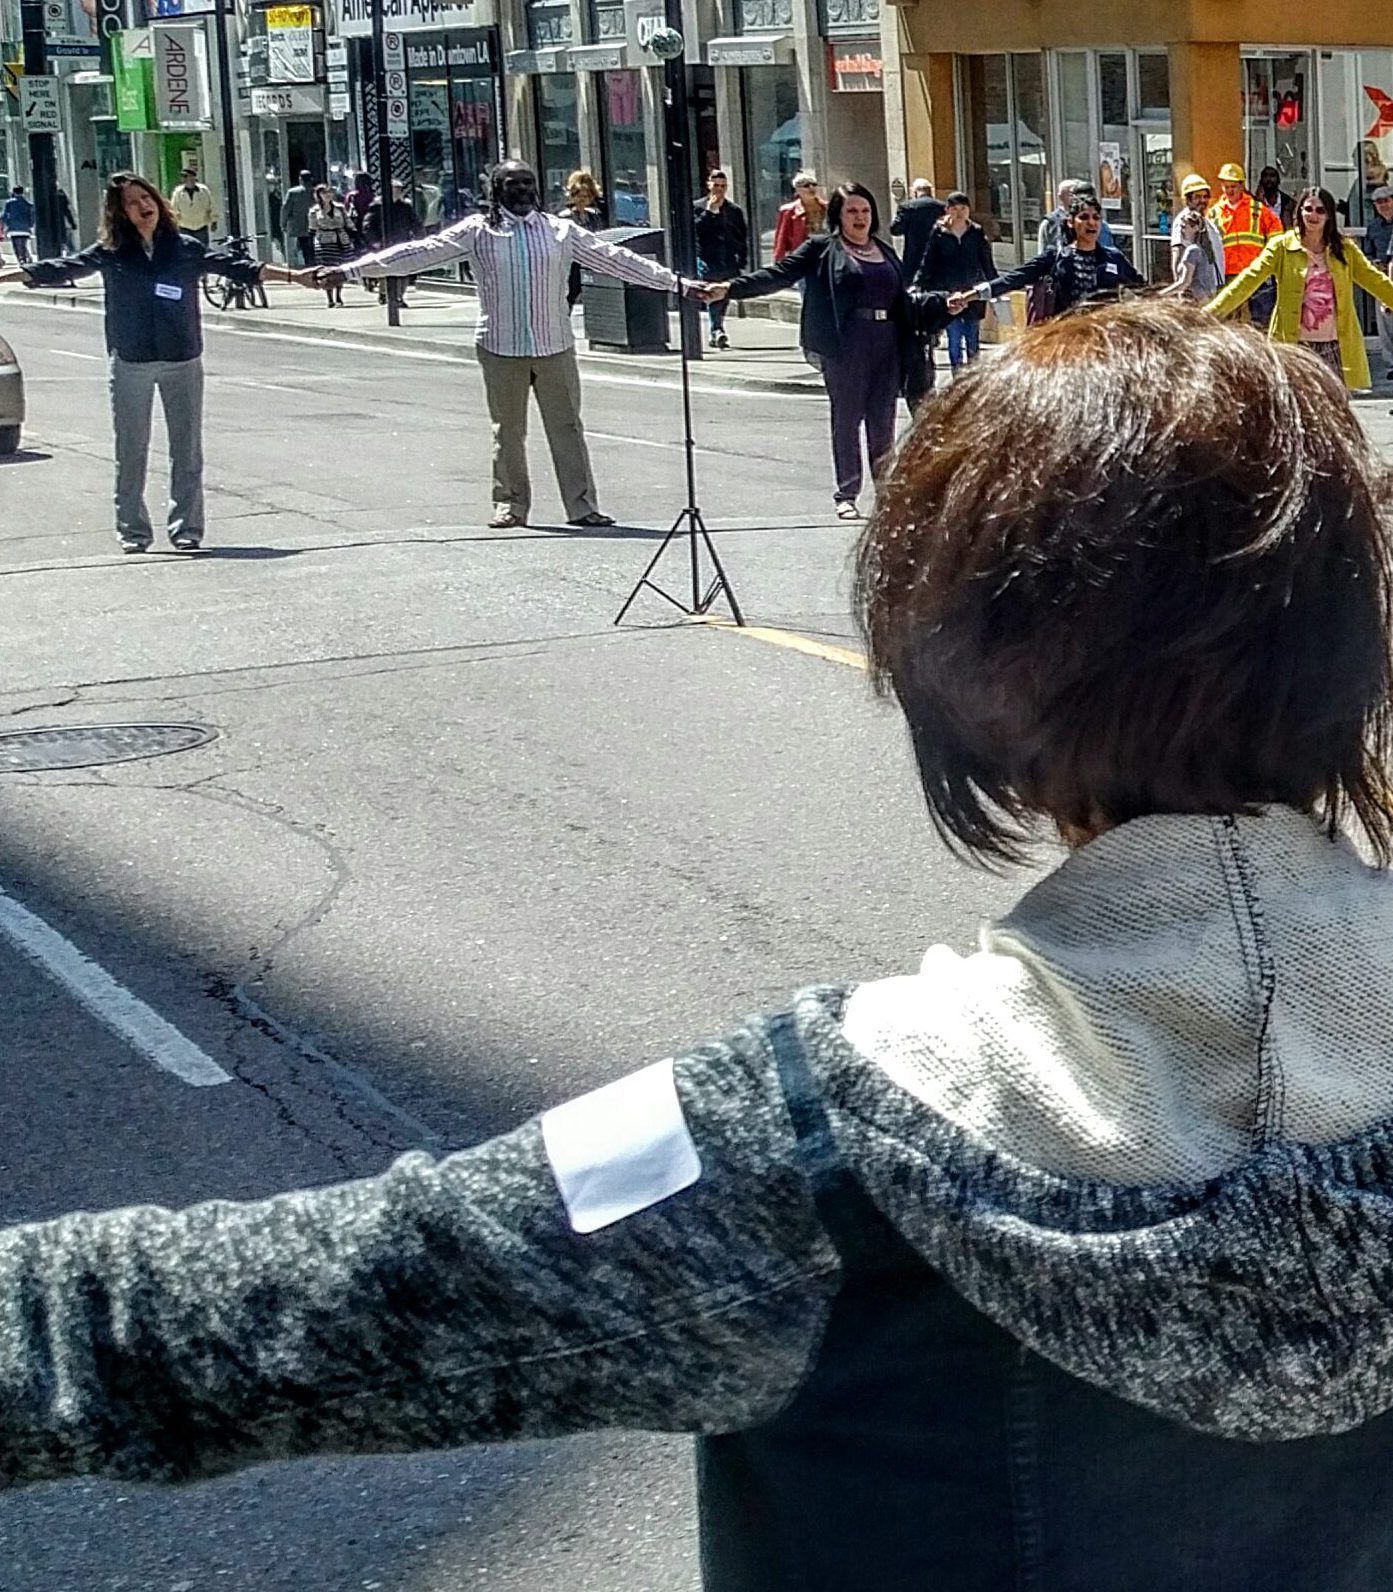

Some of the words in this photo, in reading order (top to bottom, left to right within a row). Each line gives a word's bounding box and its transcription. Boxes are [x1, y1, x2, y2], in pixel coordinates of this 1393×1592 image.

[407, 46, 428, 68] Made
[428, 45, 437, 67] in
[476, 41, 490, 63] LA
[163, 33, 190, 114] ARDENE
[28, 80, 50, 88] STOP
[29, 90, 51, 98] HERE
[44, 100, 56, 108] ON
[40, 110, 57, 118] RED
[28, 121, 58, 129] SIGNAL
